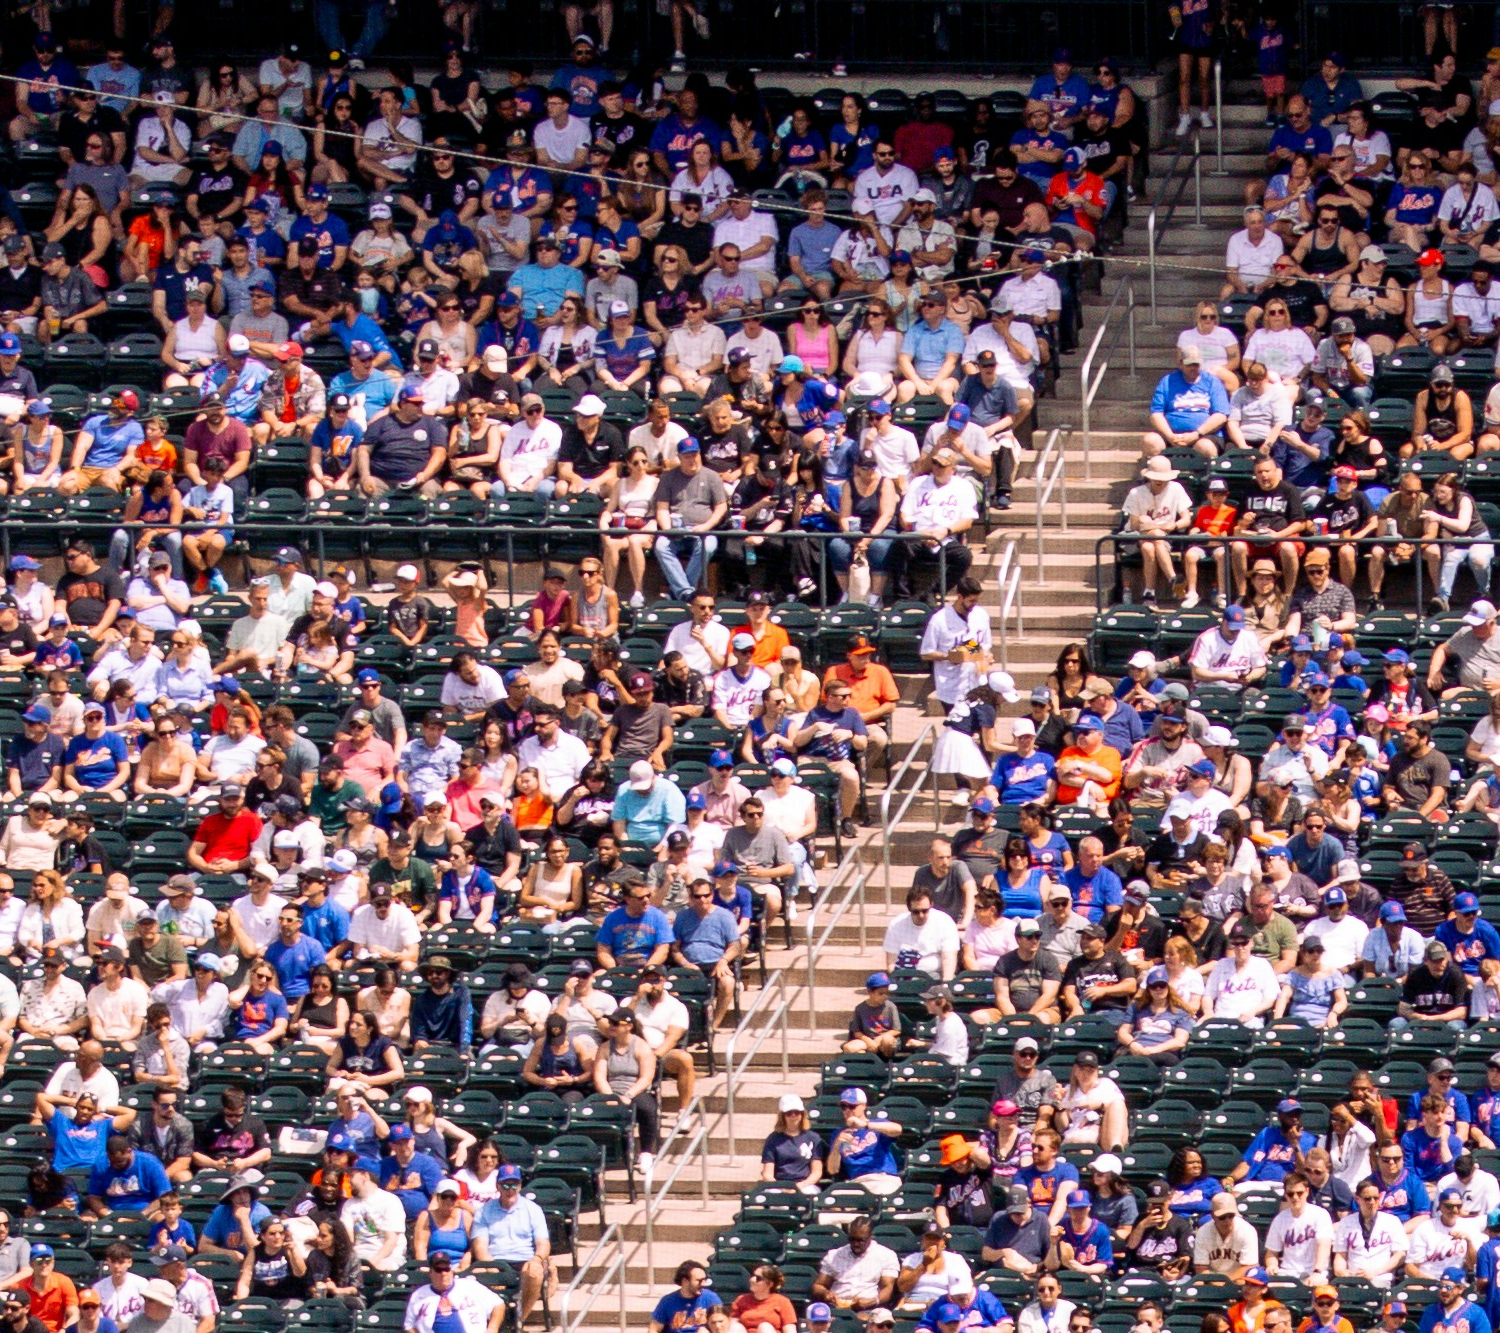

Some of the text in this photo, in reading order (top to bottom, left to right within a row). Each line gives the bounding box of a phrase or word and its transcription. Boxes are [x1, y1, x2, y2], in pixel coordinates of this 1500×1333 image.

[867, 188, 903, 201] USA
[1399, 193, 1434, 210] Mets
[513, 438, 549, 455] Mets
[1213, 656, 1249, 669] Mets
[1223, 977, 1257, 994] Mets
[1285, 1227, 1316, 1245] Mets
[1136, 1239, 1178, 1255] Mets
